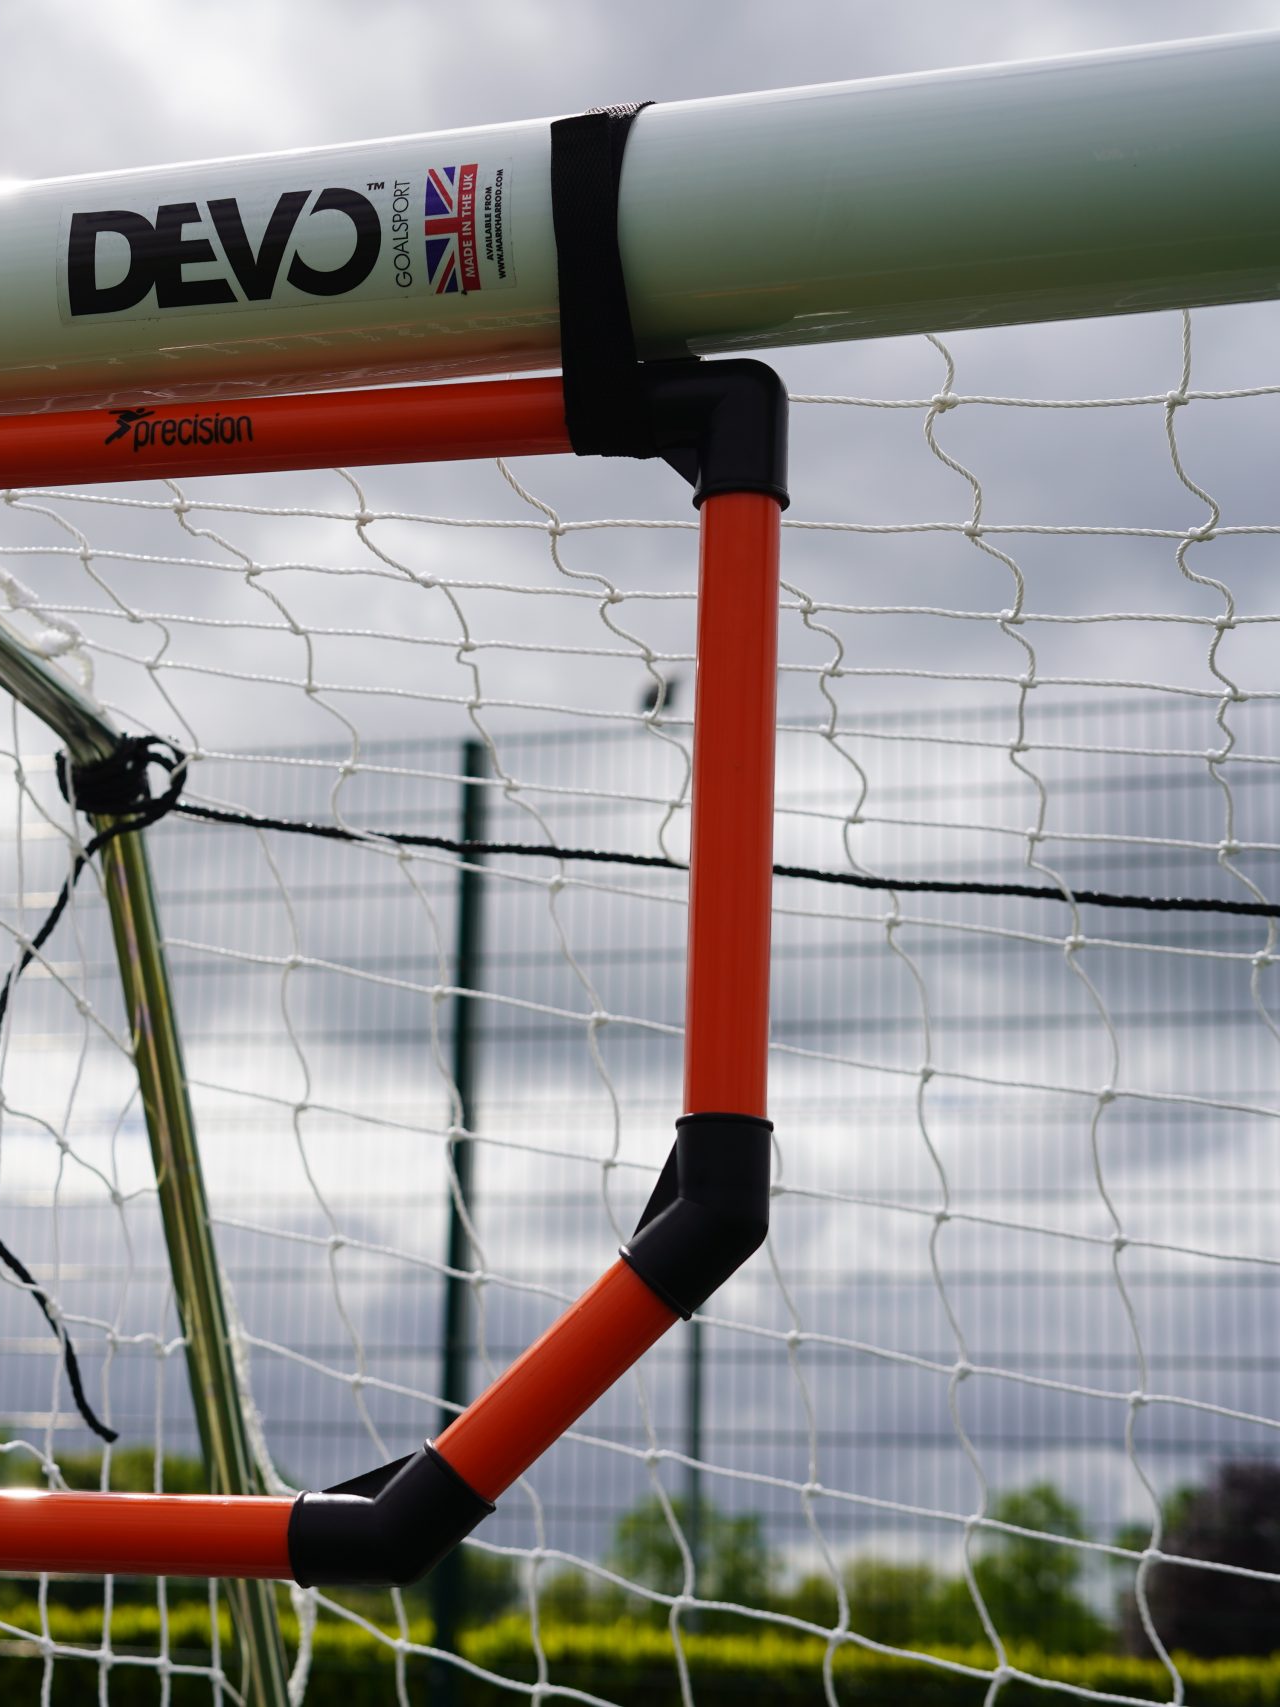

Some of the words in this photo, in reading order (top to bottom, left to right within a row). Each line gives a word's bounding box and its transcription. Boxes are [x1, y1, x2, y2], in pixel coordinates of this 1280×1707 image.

[463, 173, 474, 191] UK
[484, 186, 493, 211] FROM
[461, 194, 472, 218] THE
[494, 168, 507, 279] WWW.MARKHARROD.COM
[392, 180, 413, 288] GOALSPORT
[462, 220, 472, 236] IN
[484, 212, 494, 261] AVAILABLE
[68, 187, 381, 316] DEVO
[463, 239, 475, 278] MADE
[133, 413, 254, 453] precision
